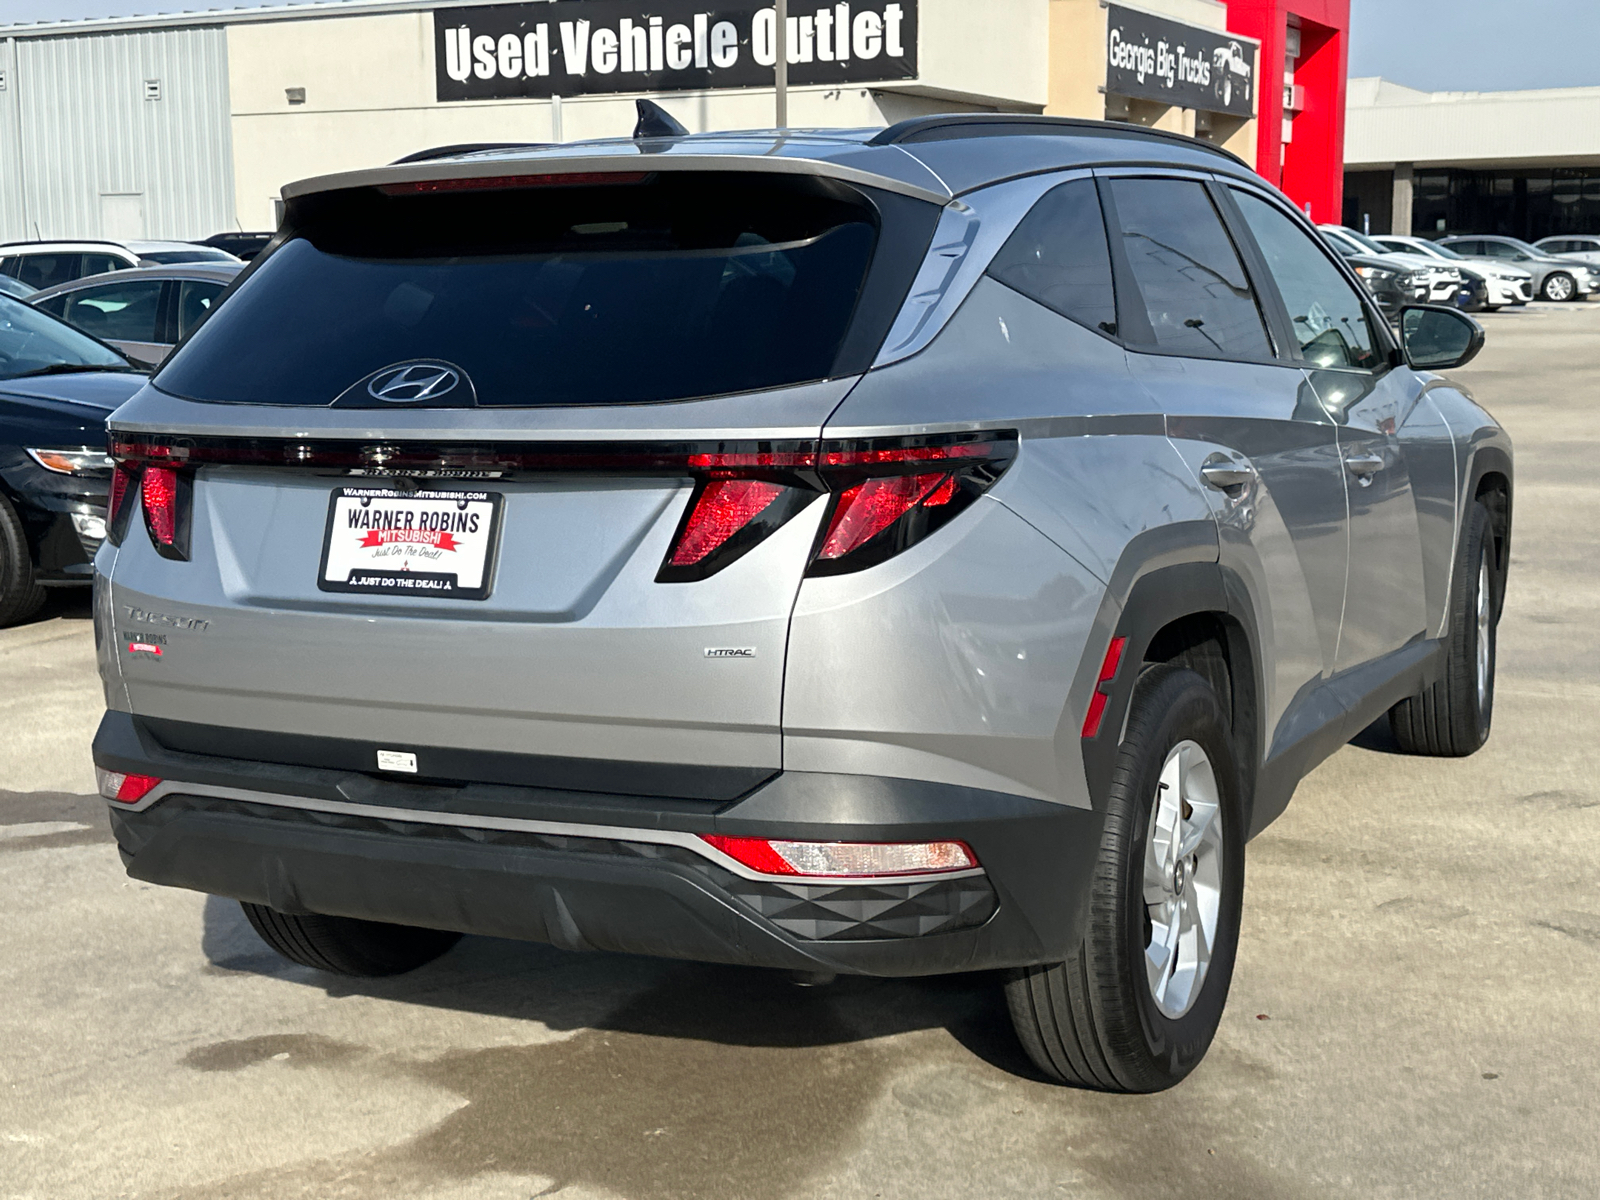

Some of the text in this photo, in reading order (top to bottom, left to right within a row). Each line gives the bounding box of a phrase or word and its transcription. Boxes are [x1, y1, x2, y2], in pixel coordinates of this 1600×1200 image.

[445, 2, 904, 81] Used Vehicle Outlet
[1110, 29, 1210, 88] Georgia Big Trucks
[348, 508, 480, 533] WARNER ROBINS
[378, 529, 442, 544] MITSUBISHI
[372, 546, 391, 558] Just
[392, 545, 402, 556] Do
[404, 545, 417, 556] The
[358, 576, 443, 589] JUST DO THE DEAL!
[707, 648, 752, 656] HTRAC
